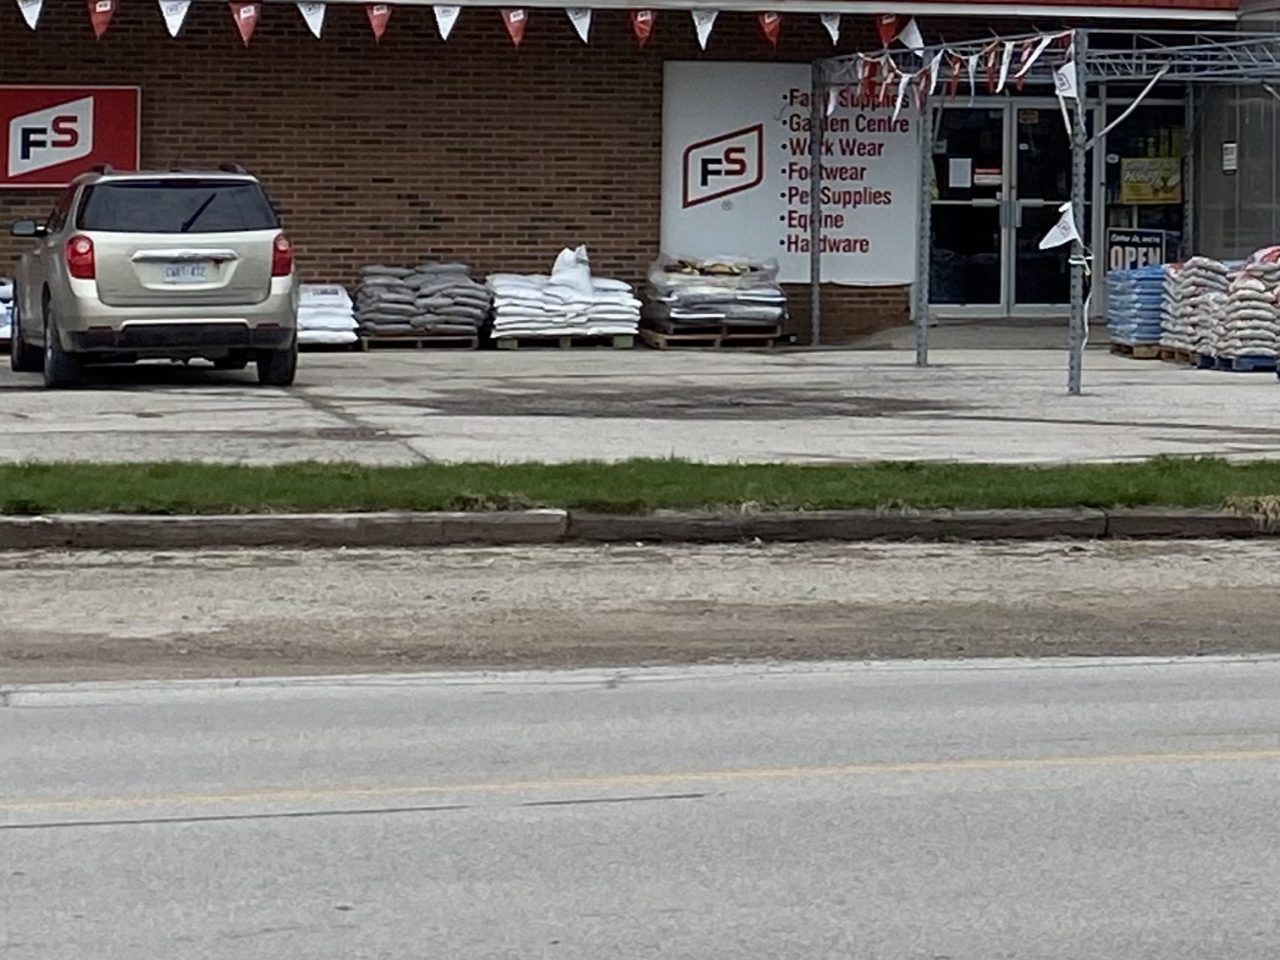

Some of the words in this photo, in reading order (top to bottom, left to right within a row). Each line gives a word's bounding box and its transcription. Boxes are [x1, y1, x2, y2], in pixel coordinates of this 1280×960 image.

[21, 116, 79, 160] FS
[839, 138, 884, 157] Wear
[701, 146, 746, 187] FS
[788, 162, 867, 181] Fotwear
[788, 187, 816, 205] Pe
[820, 186, 892, 209] Supplies
[787, 210, 844, 232] Eqine
[786, 234, 870, 254] Hadware
[1110, 245, 1161, 270] OPEN
